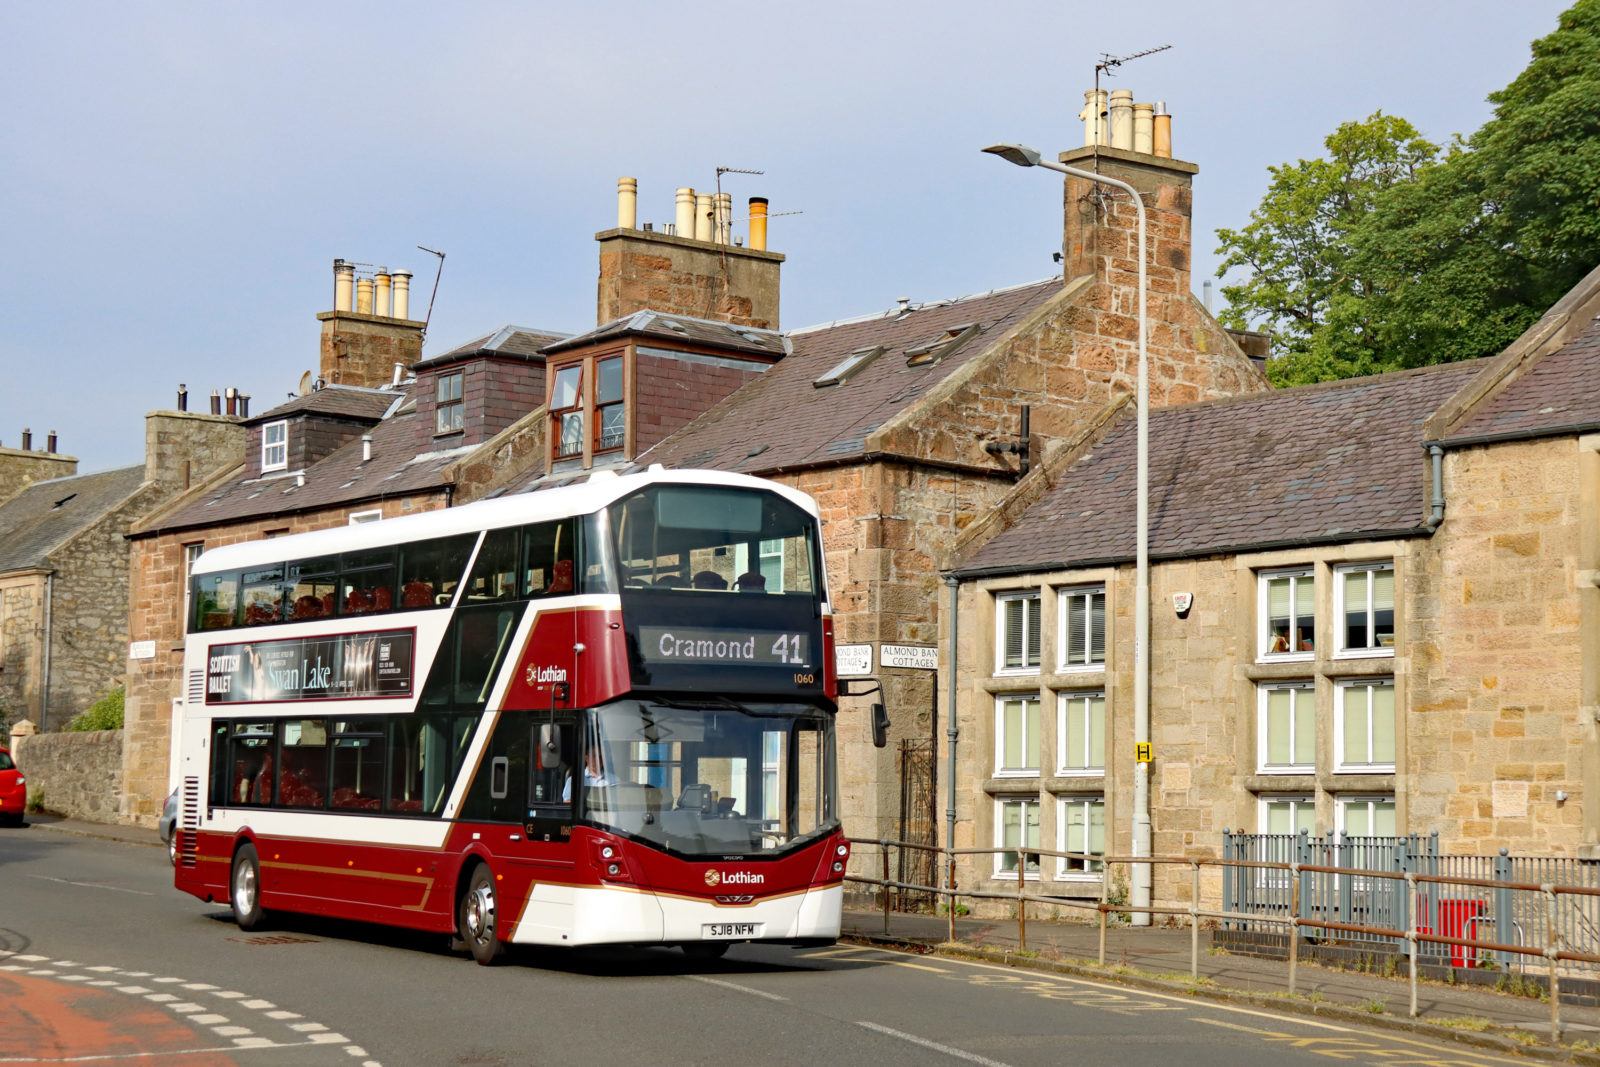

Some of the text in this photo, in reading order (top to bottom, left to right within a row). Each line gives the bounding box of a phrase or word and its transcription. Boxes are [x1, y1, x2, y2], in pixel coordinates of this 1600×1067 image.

[659, 633, 804, 664] Cramond 41
[884, 647, 938, 657] ALMOND BAN
[210, 654, 241, 674] SCOTTISH
[837, 657, 862, 667] OTTAGES
[893, 657, 934, 668] COTTAGES
[268, 655, 331, 690] Swan Lake
[537, 665, 567, 683] Lothian
[793, 673, 814, 684] 1060
[209, 675, 232, 694] BALLET
[1137, 744, 1150, 761] H
[722, 870, 765, 884] Lothian
[710, 924, 754, 936] SJ18 NFM
